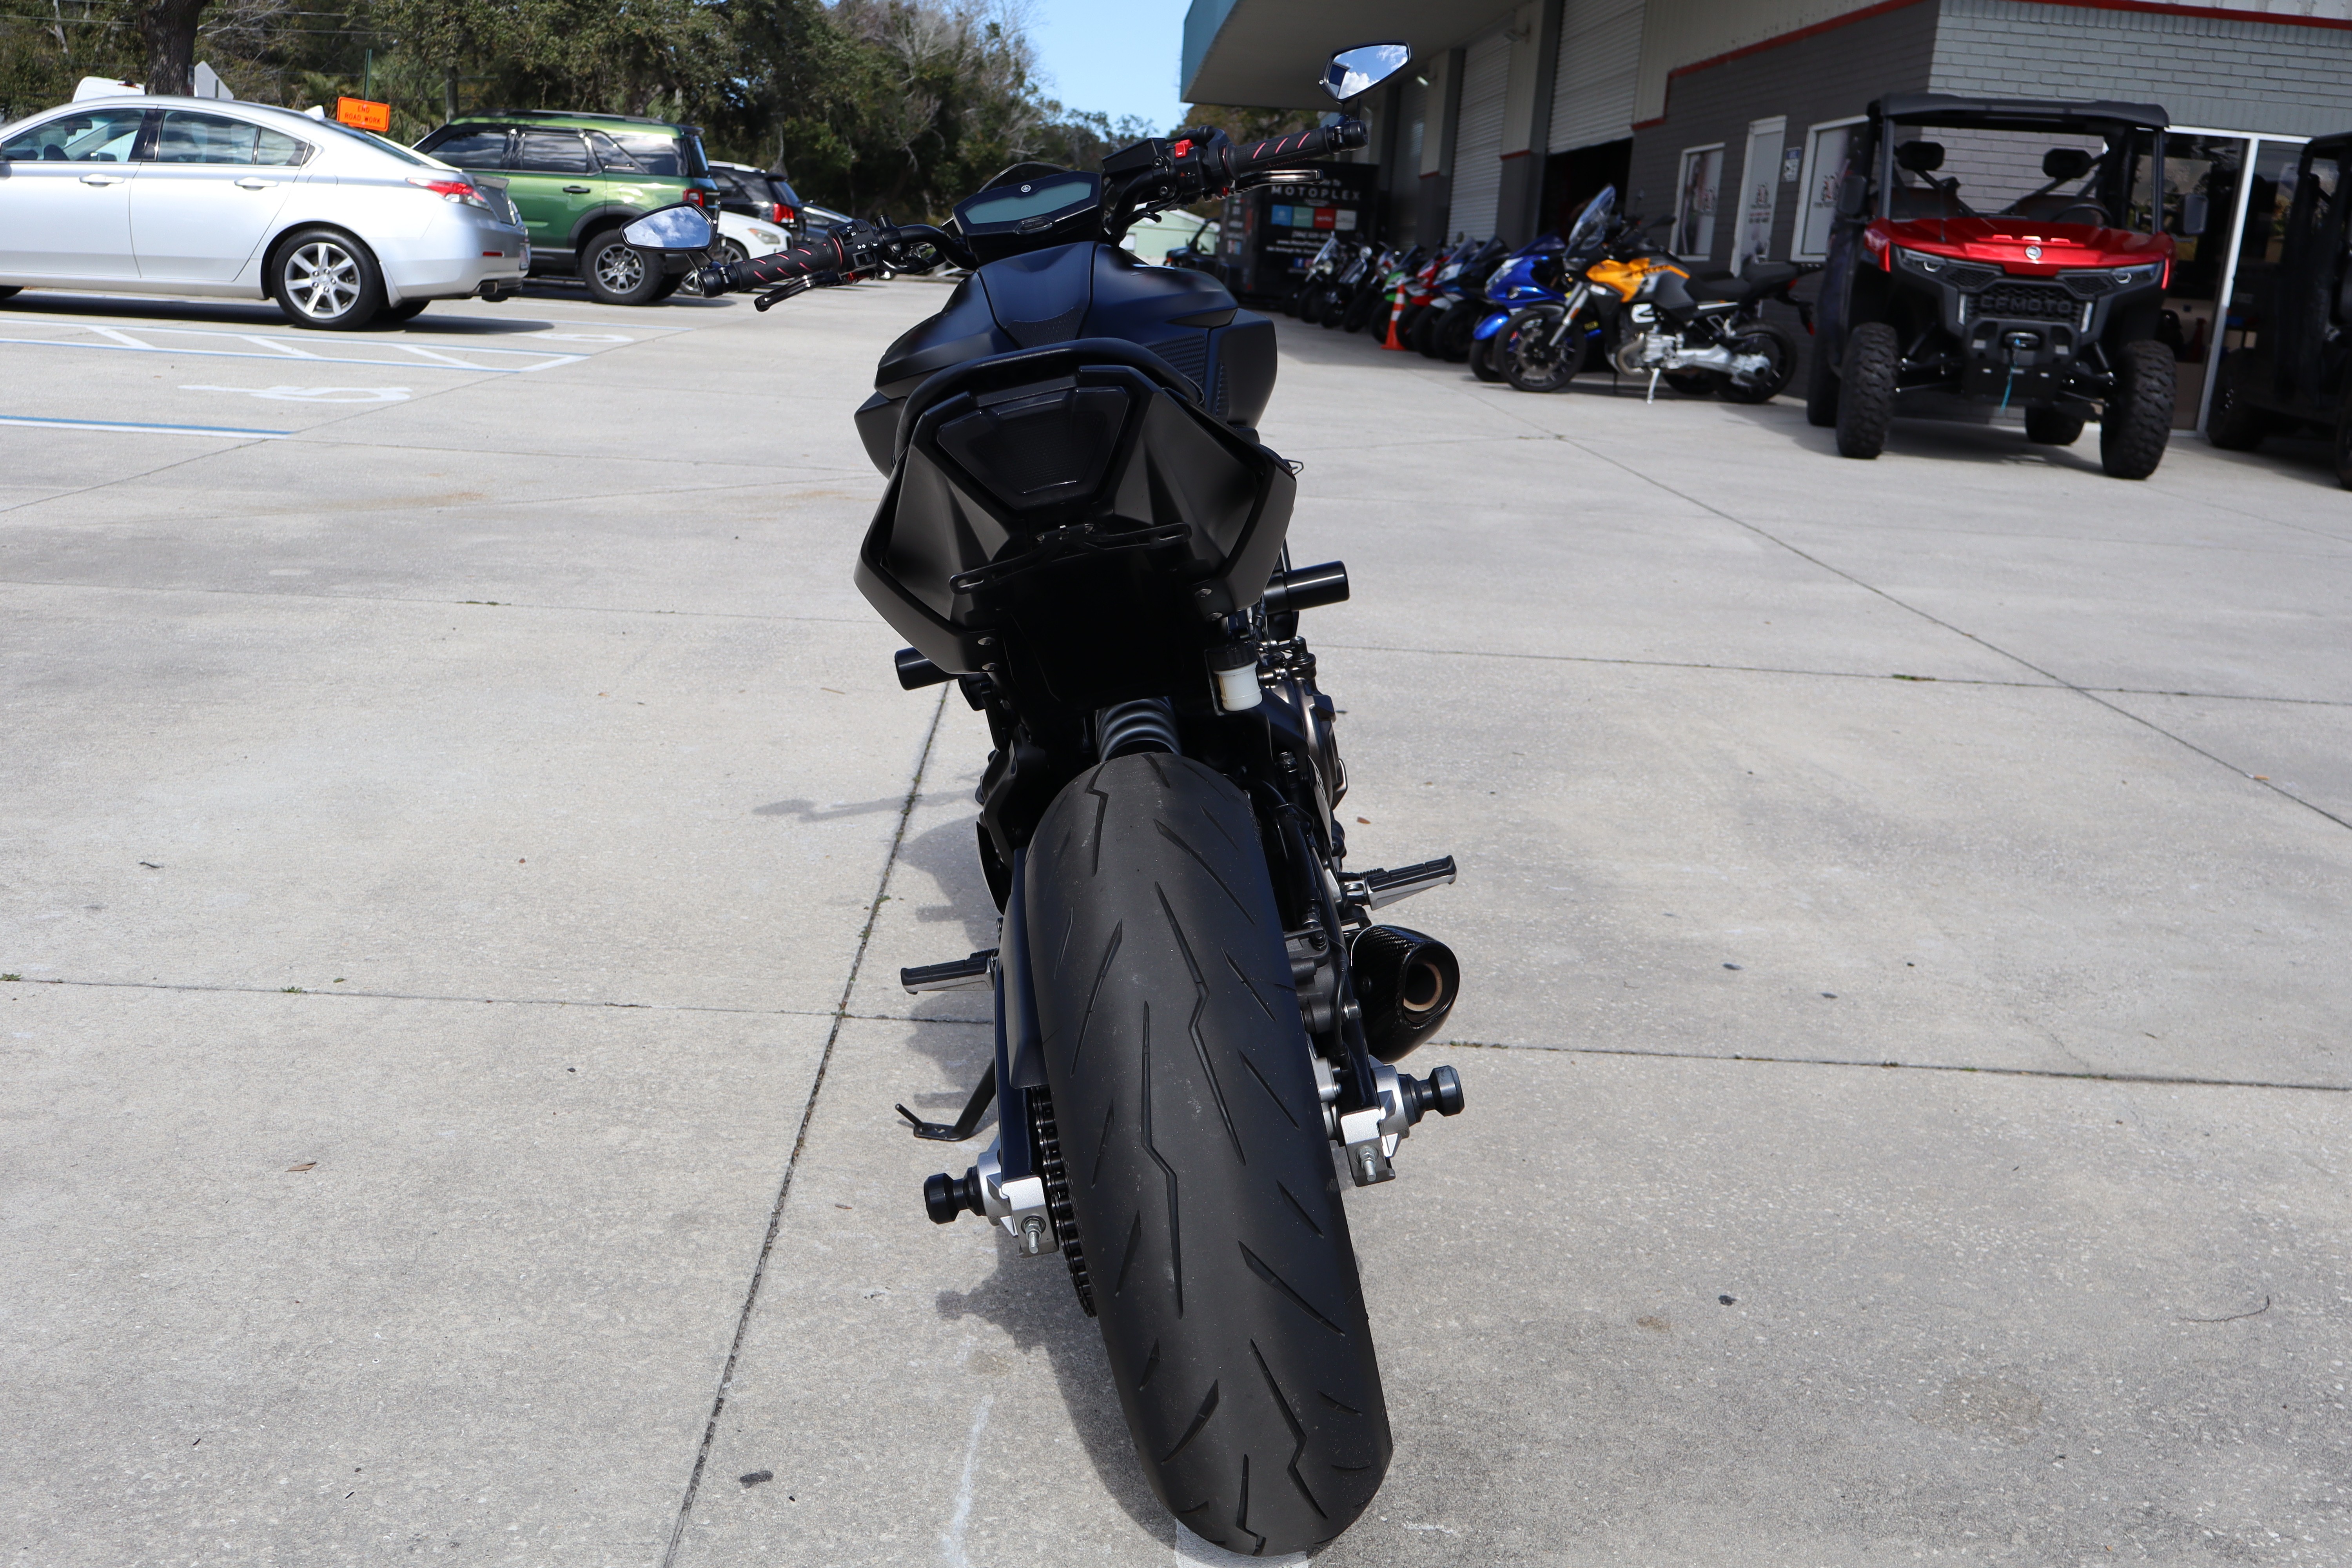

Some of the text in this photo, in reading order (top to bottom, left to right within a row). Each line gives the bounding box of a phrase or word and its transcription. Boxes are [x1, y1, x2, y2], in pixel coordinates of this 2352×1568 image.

[358, 105, 370, 113] END
[345, 113, 361, 121] ROAD
[1270, 185, 1360, 200] MOTOPLEX
[1981, 295, 2072, 313] CFMOTO
